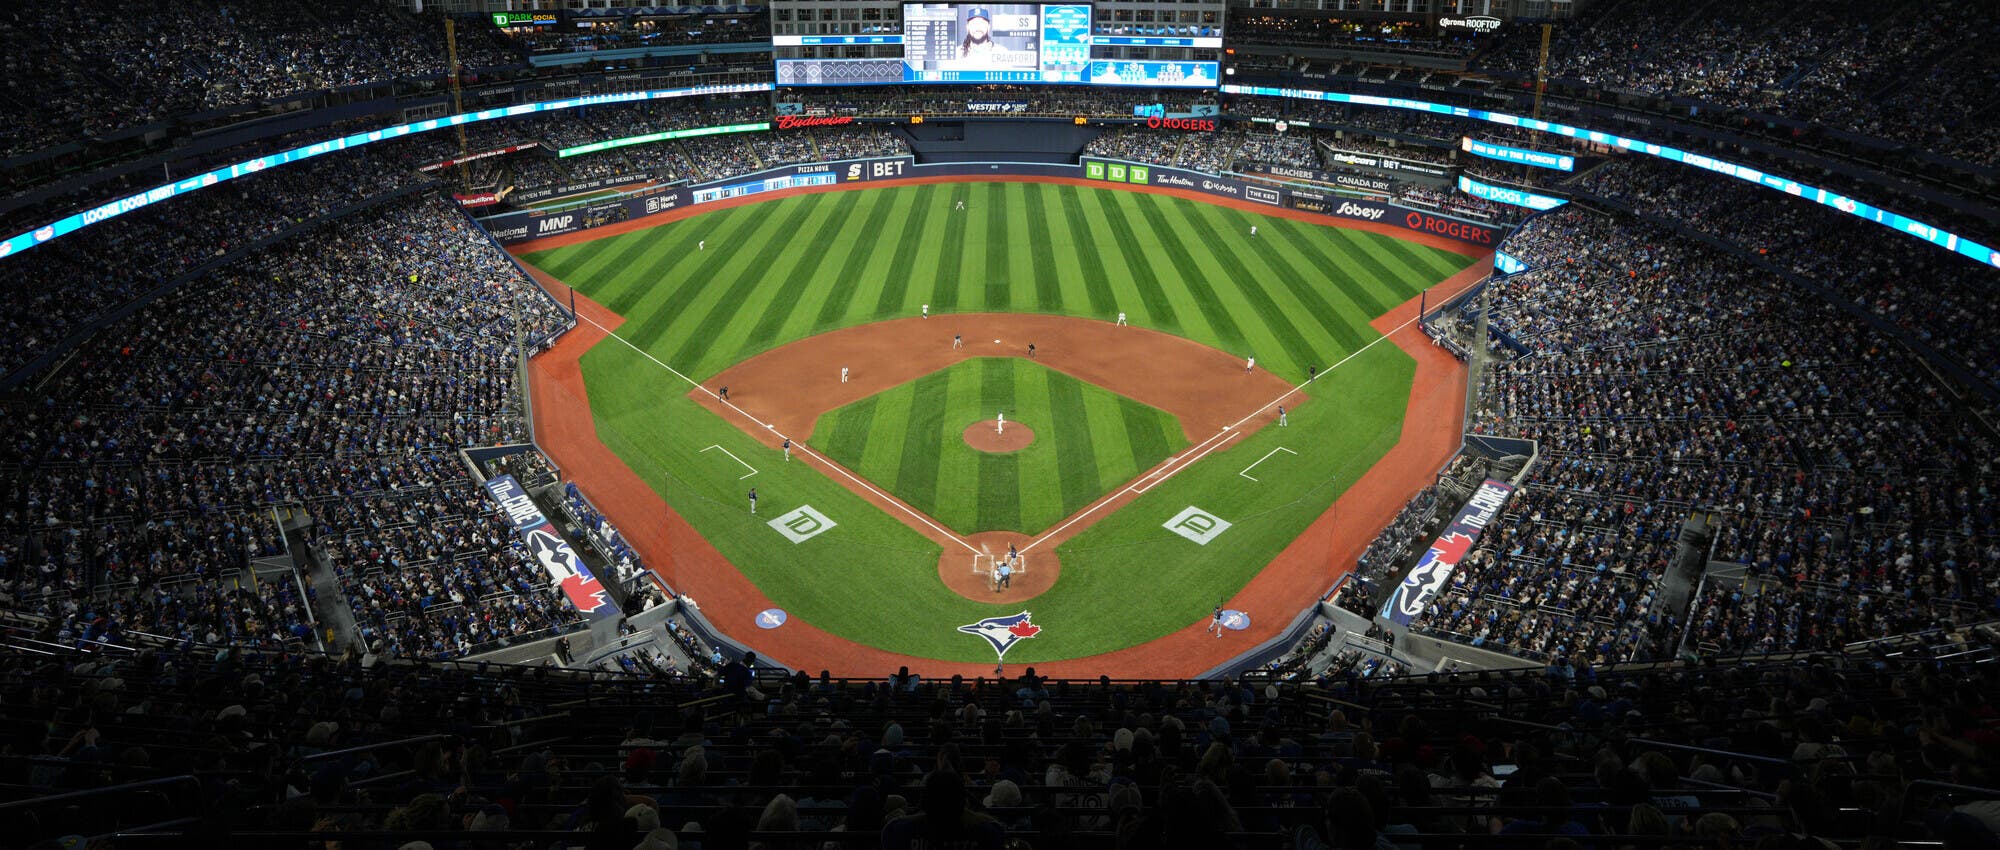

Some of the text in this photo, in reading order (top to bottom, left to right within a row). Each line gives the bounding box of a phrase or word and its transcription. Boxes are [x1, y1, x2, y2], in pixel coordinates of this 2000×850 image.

[509, 13, 532, 21] PARK
[1440, 17, 1501, 29] Corona ROOFTOP
[992, 53, 1034, 64] CRAWFORD
[967, 103, 1002, 113] WESTJET
[775, 114, 854, 129] Budweiser
[1163, 117, 1215, 131] ROGERS
[1497, 149, 1508, 157] AT
[1509, 151, 1523, 160] THE
[798, 165, 829, 174] PIZZA NOVA
[873, 160, 905, 177] BET
[1383, 160, 1400, 170] BET
[615, 173, 647, 184] NEXEN TIRE
[1271, 167, 1313, 179] BLEACHERS
[568, 181, 600, 192] NEXEN TIRE
[1157, 174, 1194, 187] Tim Hortons
[1337, 175, 1389, 190] CANADA DRY
[518, 189, 552, 201] NEXEN TIRE
[1213, 183, 1237, 194] Kubota
[1250, 190, 1275, 200] THE KEG
[1472, 184, 1489, 196] HOT
[1490, 187, 1521, 202] DOGS
[83, 184, 176, 225] LOONIE DOGS NIGHT
[660, 194, 678, 202] Here's
[1337, 201, 1384, 220] Sobeys
[539, 215, 573, 233] MNP
[1425, 217, 1491, 244] ROGERS
[490, 480, 514, 493] TO
[502, 495, 543, 525] CORE
[1469, 483, 1509, 512] CORE
[785, 510, 823, 536] TD
[1173, 513, 1217, 535] TD
[1460, 514, 1486, 529] TO
